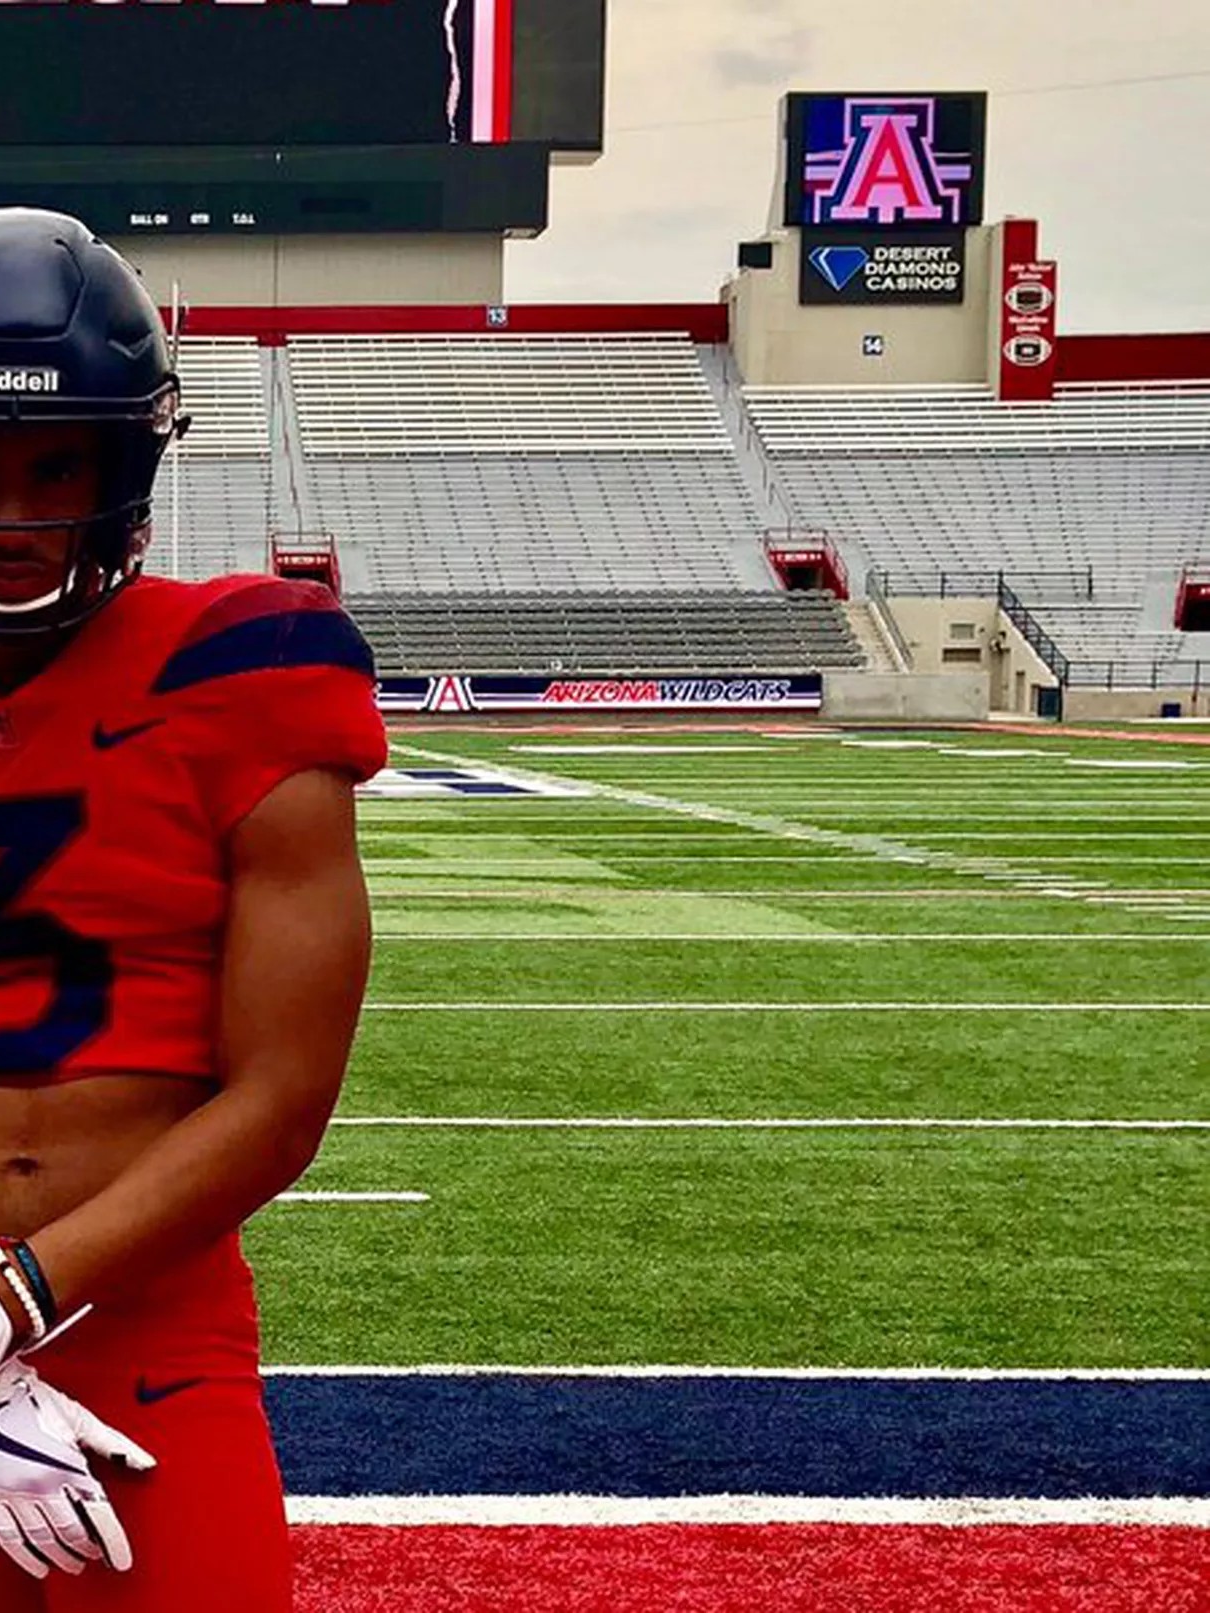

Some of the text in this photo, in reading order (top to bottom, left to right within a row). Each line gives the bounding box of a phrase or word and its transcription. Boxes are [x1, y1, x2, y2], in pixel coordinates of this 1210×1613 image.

[874, 246, 951, 261] DESERT
[864, 262, 961, 276] DIAMOND
[866, 276, 957, 291] CASINOS
